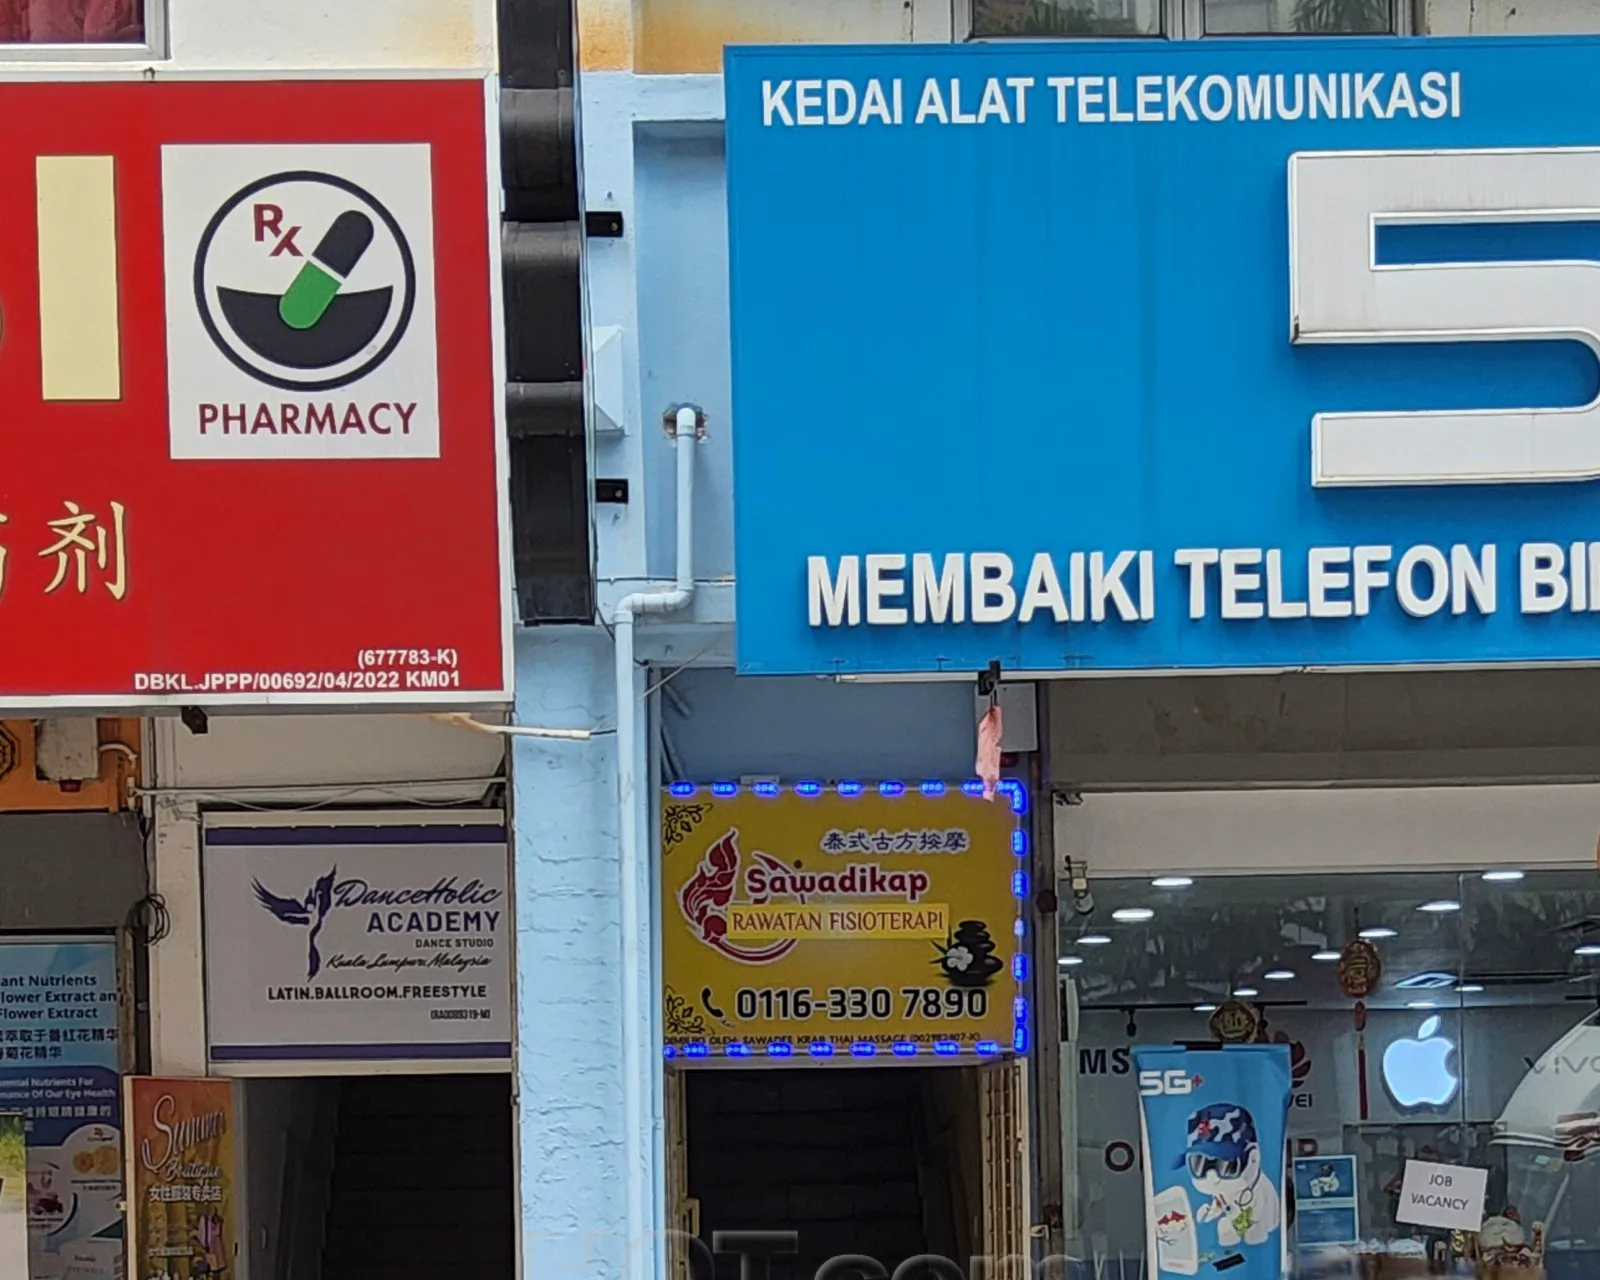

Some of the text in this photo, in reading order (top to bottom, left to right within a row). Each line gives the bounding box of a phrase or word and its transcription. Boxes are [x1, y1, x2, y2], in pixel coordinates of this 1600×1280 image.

[762, 72, 1463, 127] KEDAI ALAT TELEKOMUNIKASI
[199, 402, 418, 435] PHARMACY
[0, 500, 128, 600] 剂
[807, 550, 1155, 627] MEMBAIKI
[1174, 545, 1496, 619] TELEFON
[357, 648, 458, 668] (677783-K)
[134, 670, 460, 690] DBKL.JPPP/00692/04/2022 KM01
[824, 831, 967, 852] 泰式古方按摩
[746, 864, 928, 901] Sawadikap
[367, 911, 500, 933] ACADEMY
[733, 911, 943, 931] RAWATAN FISIOTERAPI
[416, 938, 494, 949] DANCE STUDIO
[326, 954, 367, 970] Kuala
[427, 952, 492, 973] Malaysia
[0, 975, 97, 987] ant Nutrients
[45, 991, 96, 1003] Extract
[736, 988, 987, 1018] 0116-330 7890
[48, 1007, 98, 1019] Extract
[1428, 1174, 1453, 1187] JOB
[1411, 1192, 1468, 1210] VACANCY
